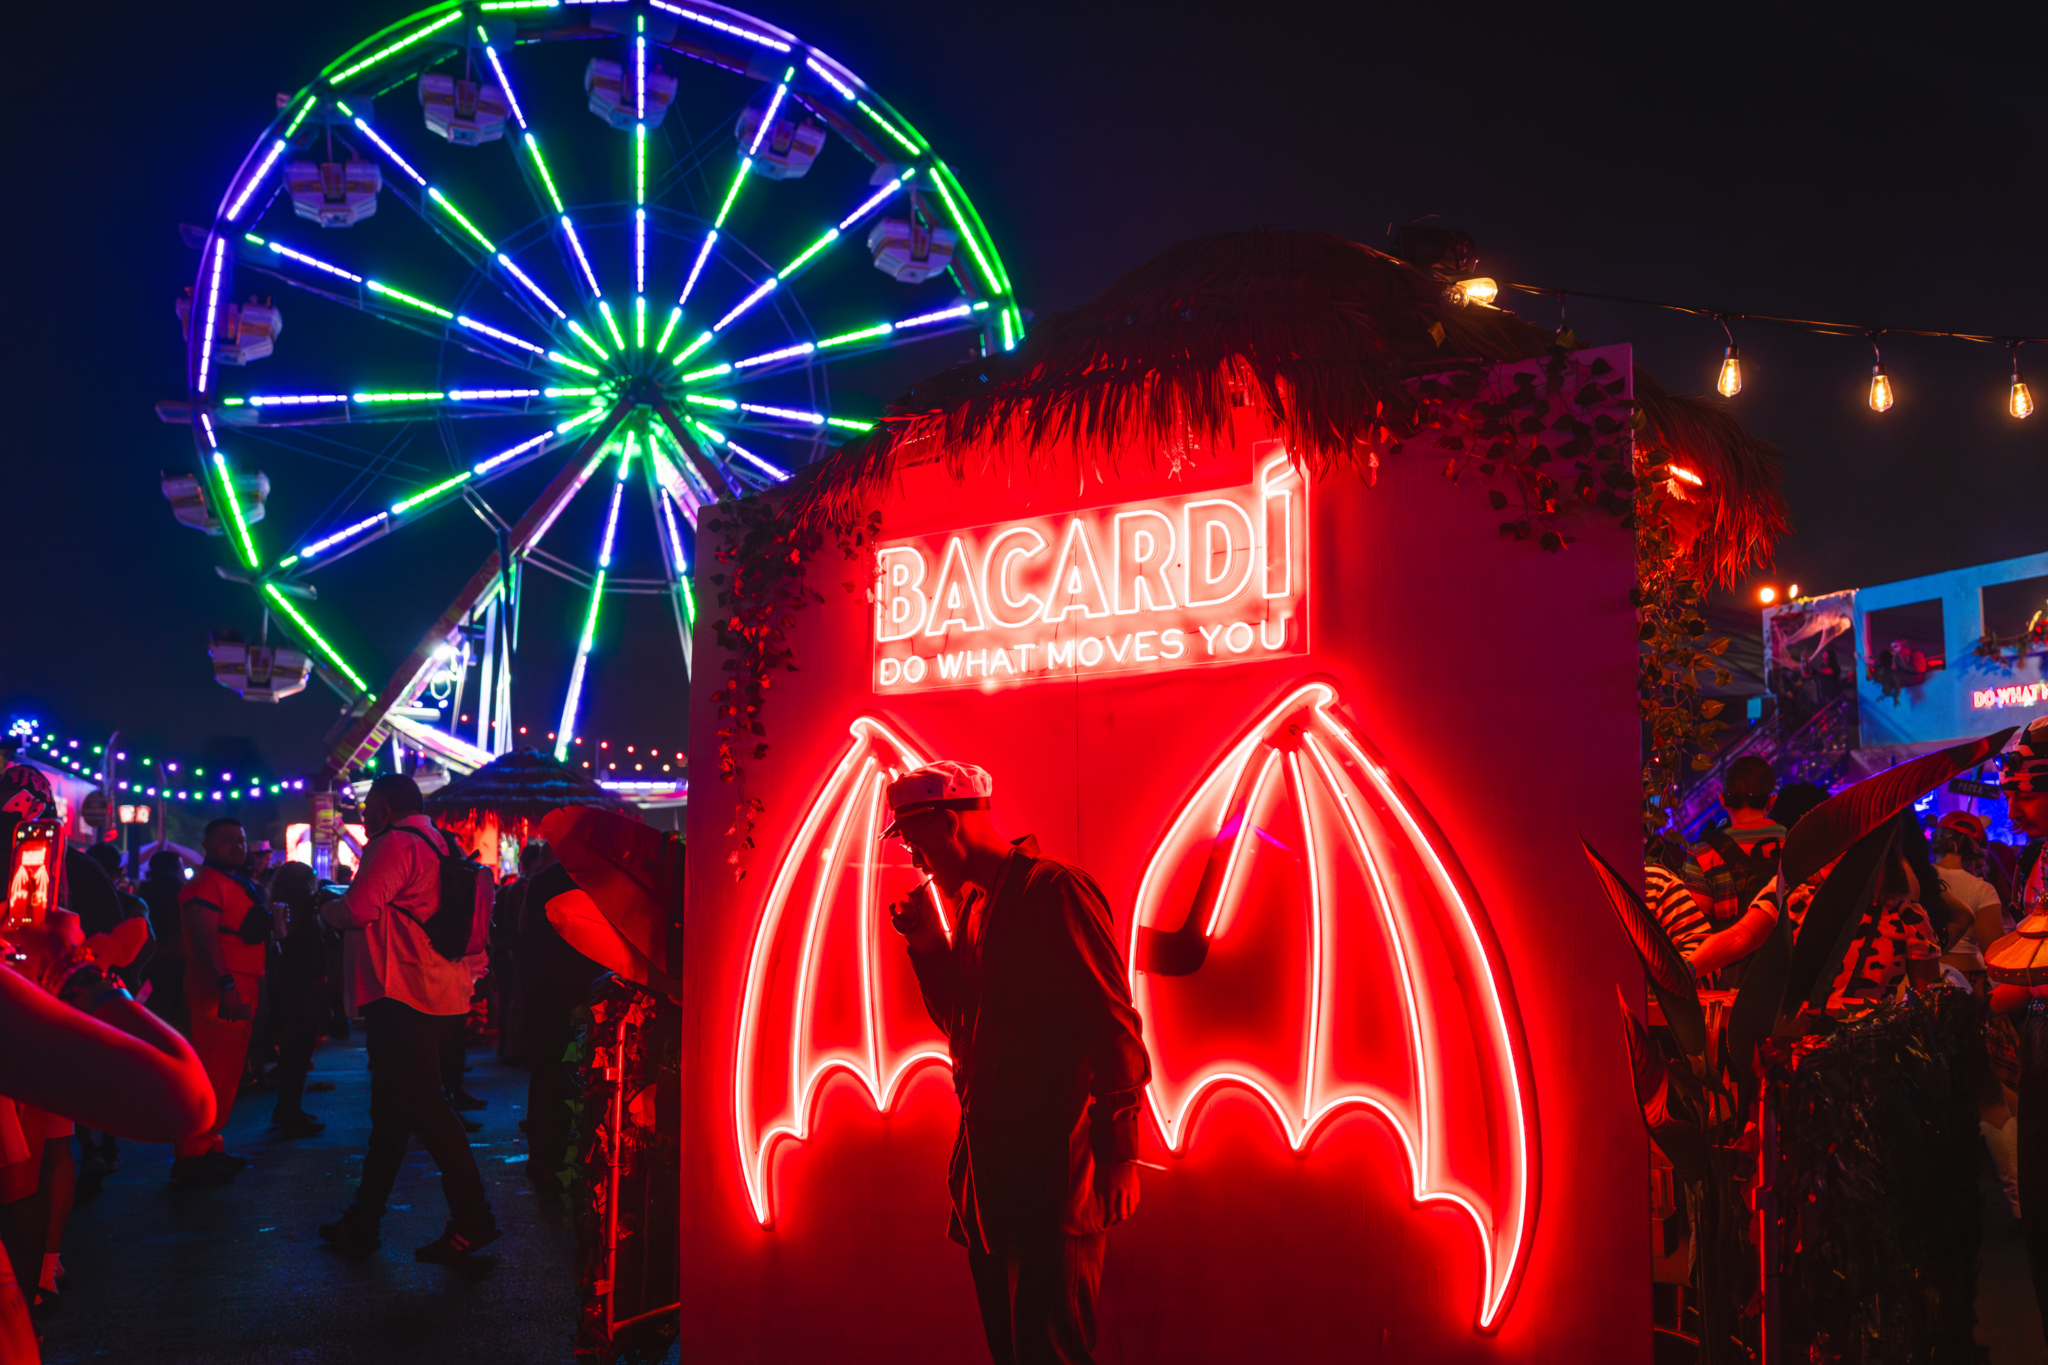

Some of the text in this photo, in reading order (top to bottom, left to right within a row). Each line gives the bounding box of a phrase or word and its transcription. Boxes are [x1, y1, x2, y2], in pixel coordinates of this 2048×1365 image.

[876, 454, 1295, 641] BACARDÍ
[880, 616, 1290, 685] DO WHAT MOVES YOU
[1974, 691, 1996, 708] DO
[1997, 684, 2039, 704] WHAT
